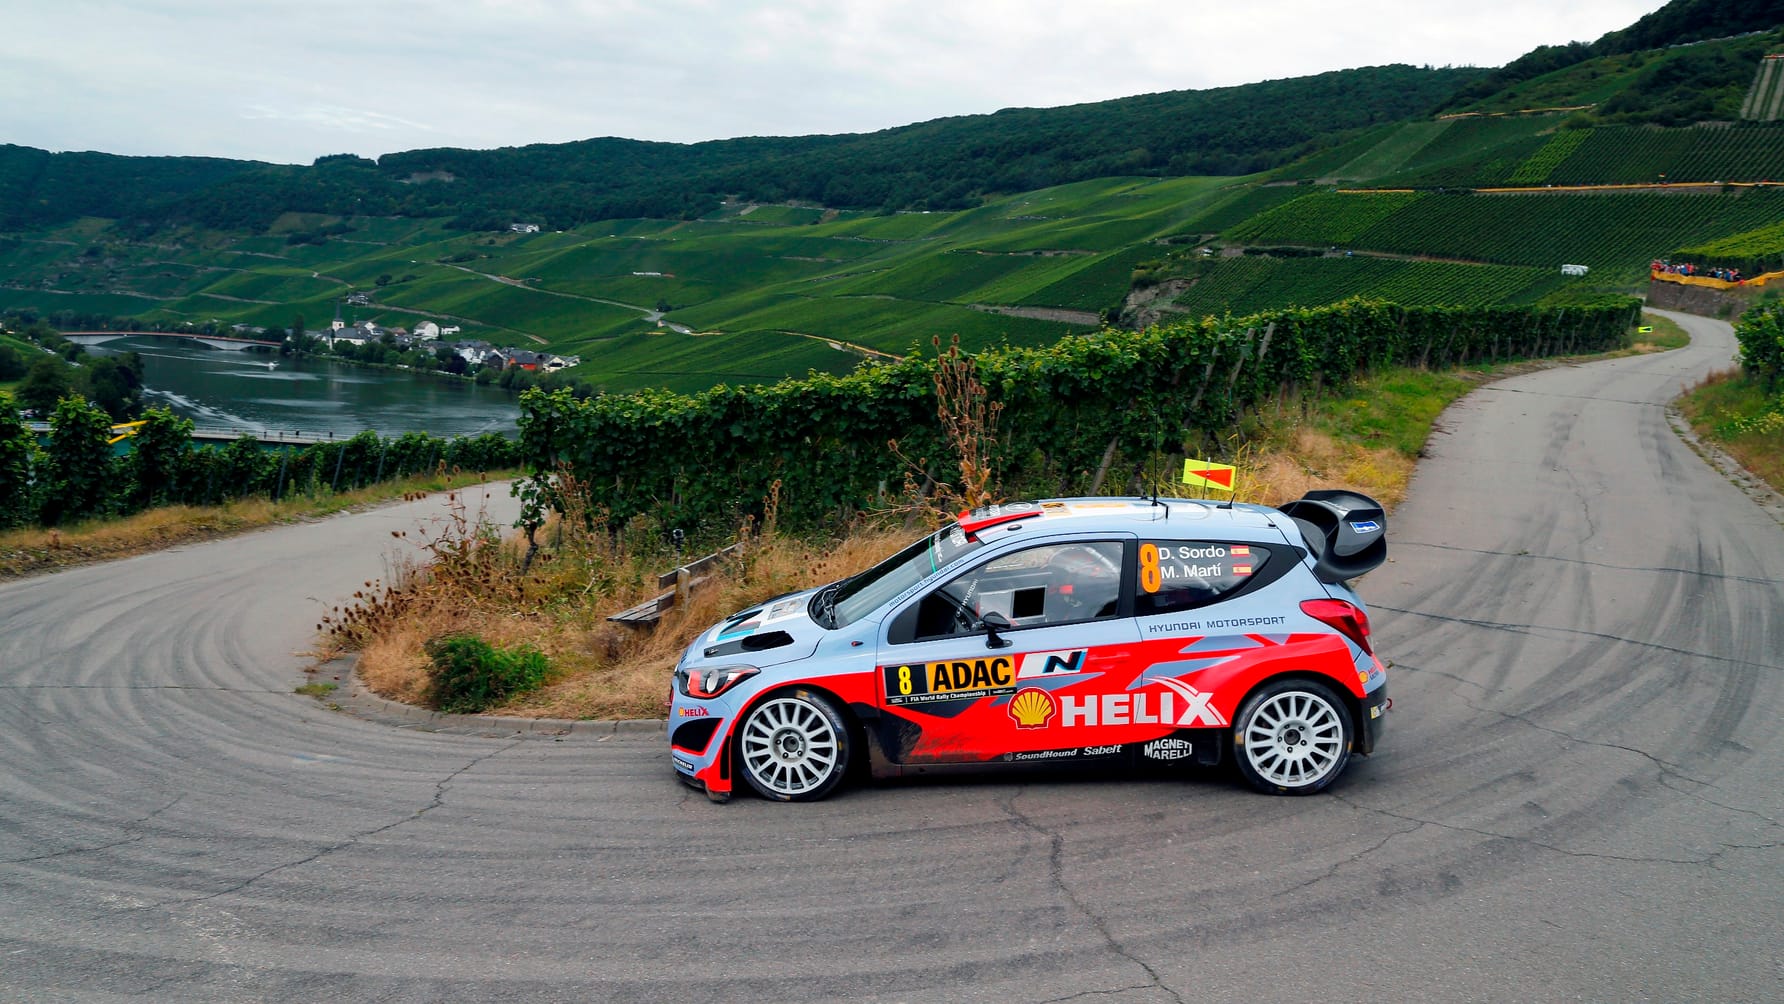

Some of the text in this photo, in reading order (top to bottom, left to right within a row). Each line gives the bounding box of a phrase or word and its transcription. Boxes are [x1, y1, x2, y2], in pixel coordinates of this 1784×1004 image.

[1158, 545, 1226, 560] D. Sordo
[1139, 543, 1162, 593] 8
[1161, 562, 1222, 579] M. Martí
[1149, 616, 1286, 633] HYUNDAI MOTORSPORT
[898, 658, 1011, 695] 8 ADAC
[1059, 676, 1228, 727] HELIX
[684, 705, 710, 717] HELIX
[1015, 744, 1123, 761] SoundHound Sabelt
